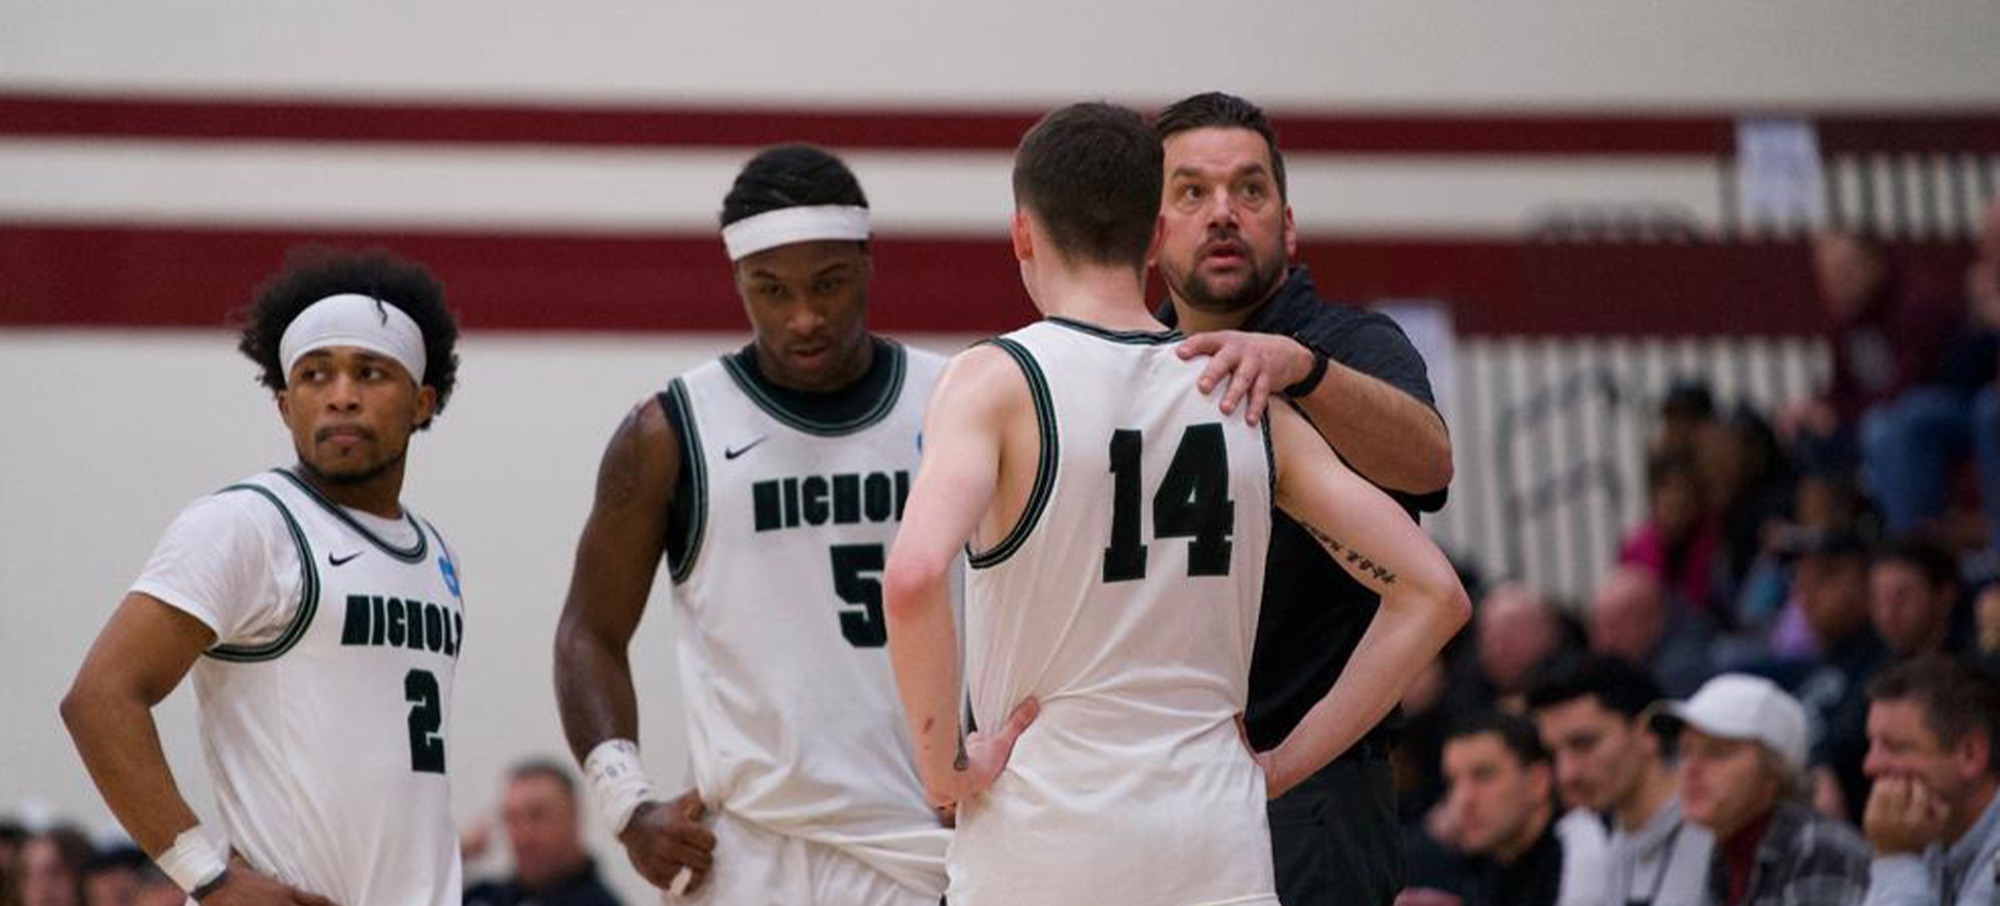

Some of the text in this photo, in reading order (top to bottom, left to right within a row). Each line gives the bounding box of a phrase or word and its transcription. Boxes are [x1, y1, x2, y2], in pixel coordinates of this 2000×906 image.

[1103, 423, 1235, 582] 14
[830, 543, 888, 648] 5
[405, 668, 445, 774] 2
